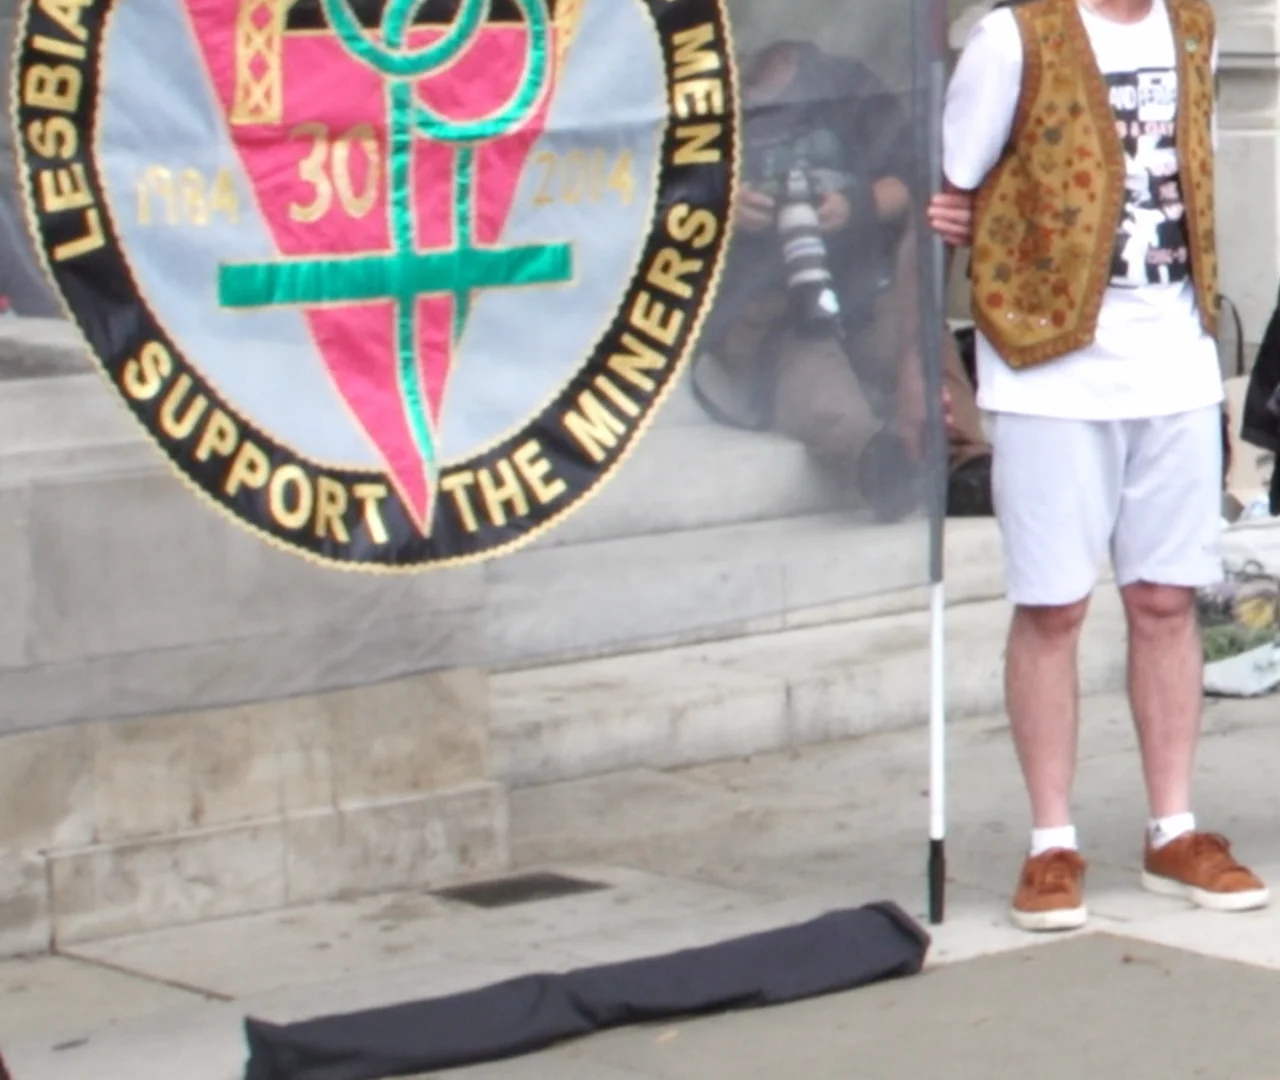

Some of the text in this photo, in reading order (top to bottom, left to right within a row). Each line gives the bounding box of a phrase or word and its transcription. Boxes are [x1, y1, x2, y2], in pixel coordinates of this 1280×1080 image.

[671, 22, 725, 166] MEN
[137, 162, 241, 226] 1984
[287, 123, 381, 224] 30
[531, 149, 638, 207] 2014
[122, 202, 718, 545] SUPPORT THE MINERS
